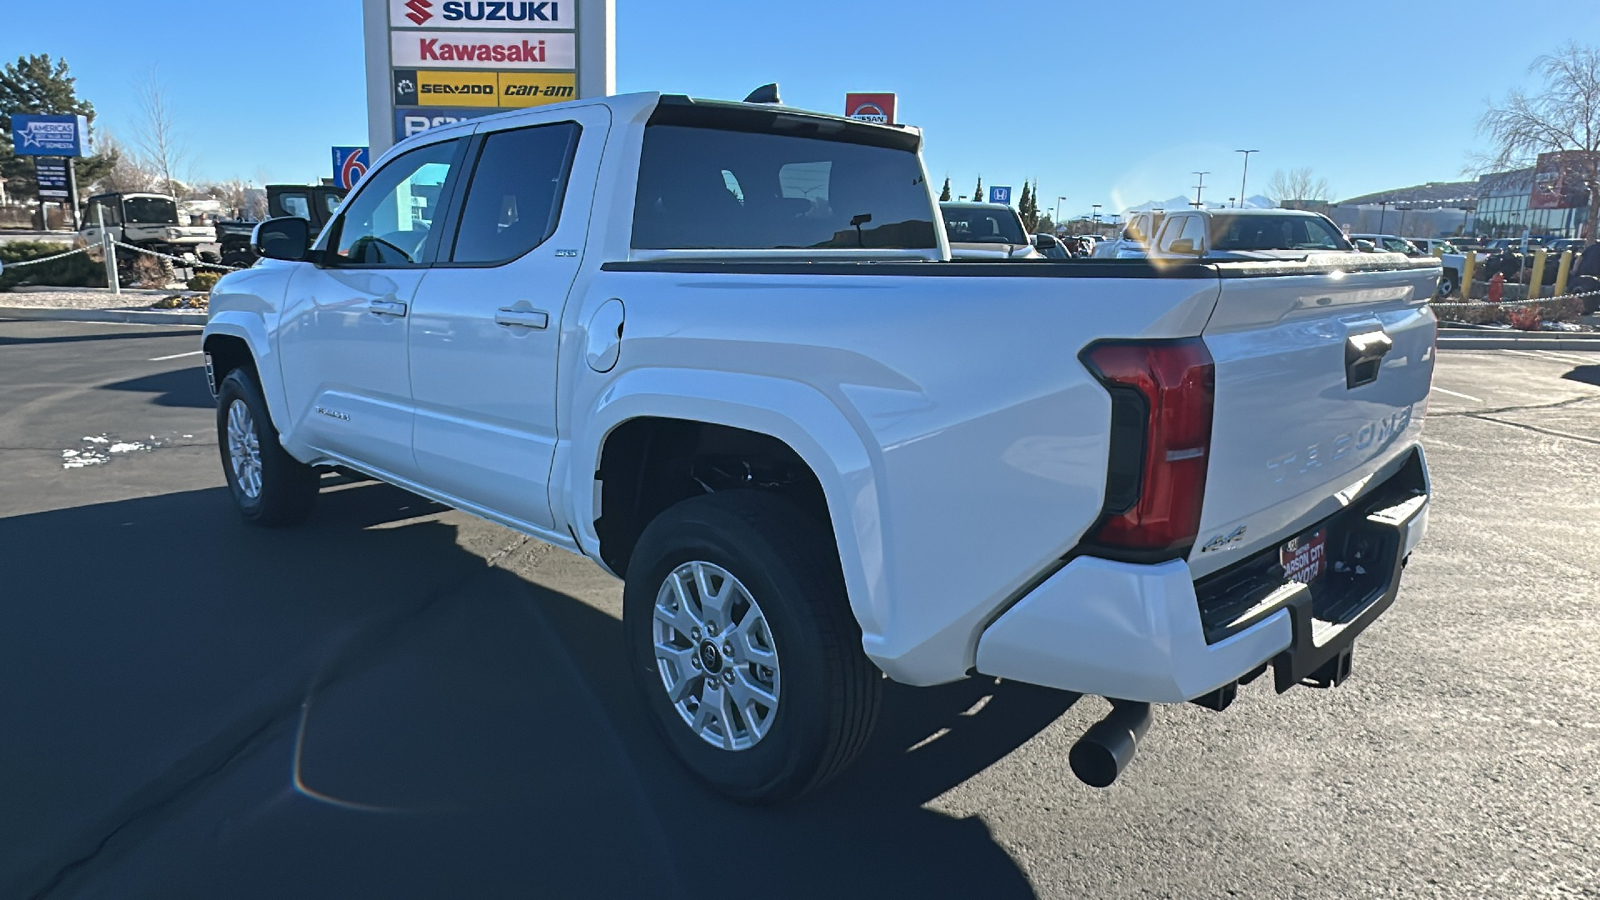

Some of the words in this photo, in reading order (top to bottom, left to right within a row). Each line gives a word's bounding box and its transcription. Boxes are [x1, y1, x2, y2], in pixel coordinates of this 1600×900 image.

[443, 1, 558, 21] SUZUKI
[419, 38, 546, 62] Kawasaki
[33, 124, 72, 132] AMERICAS
[341, 148, 368, 190] 6
[1267, 405, 1412, 483] TACOMA
[1310, 542, 1324, 562] CITY
[1288, 560, 1319, 583] OYOTA
